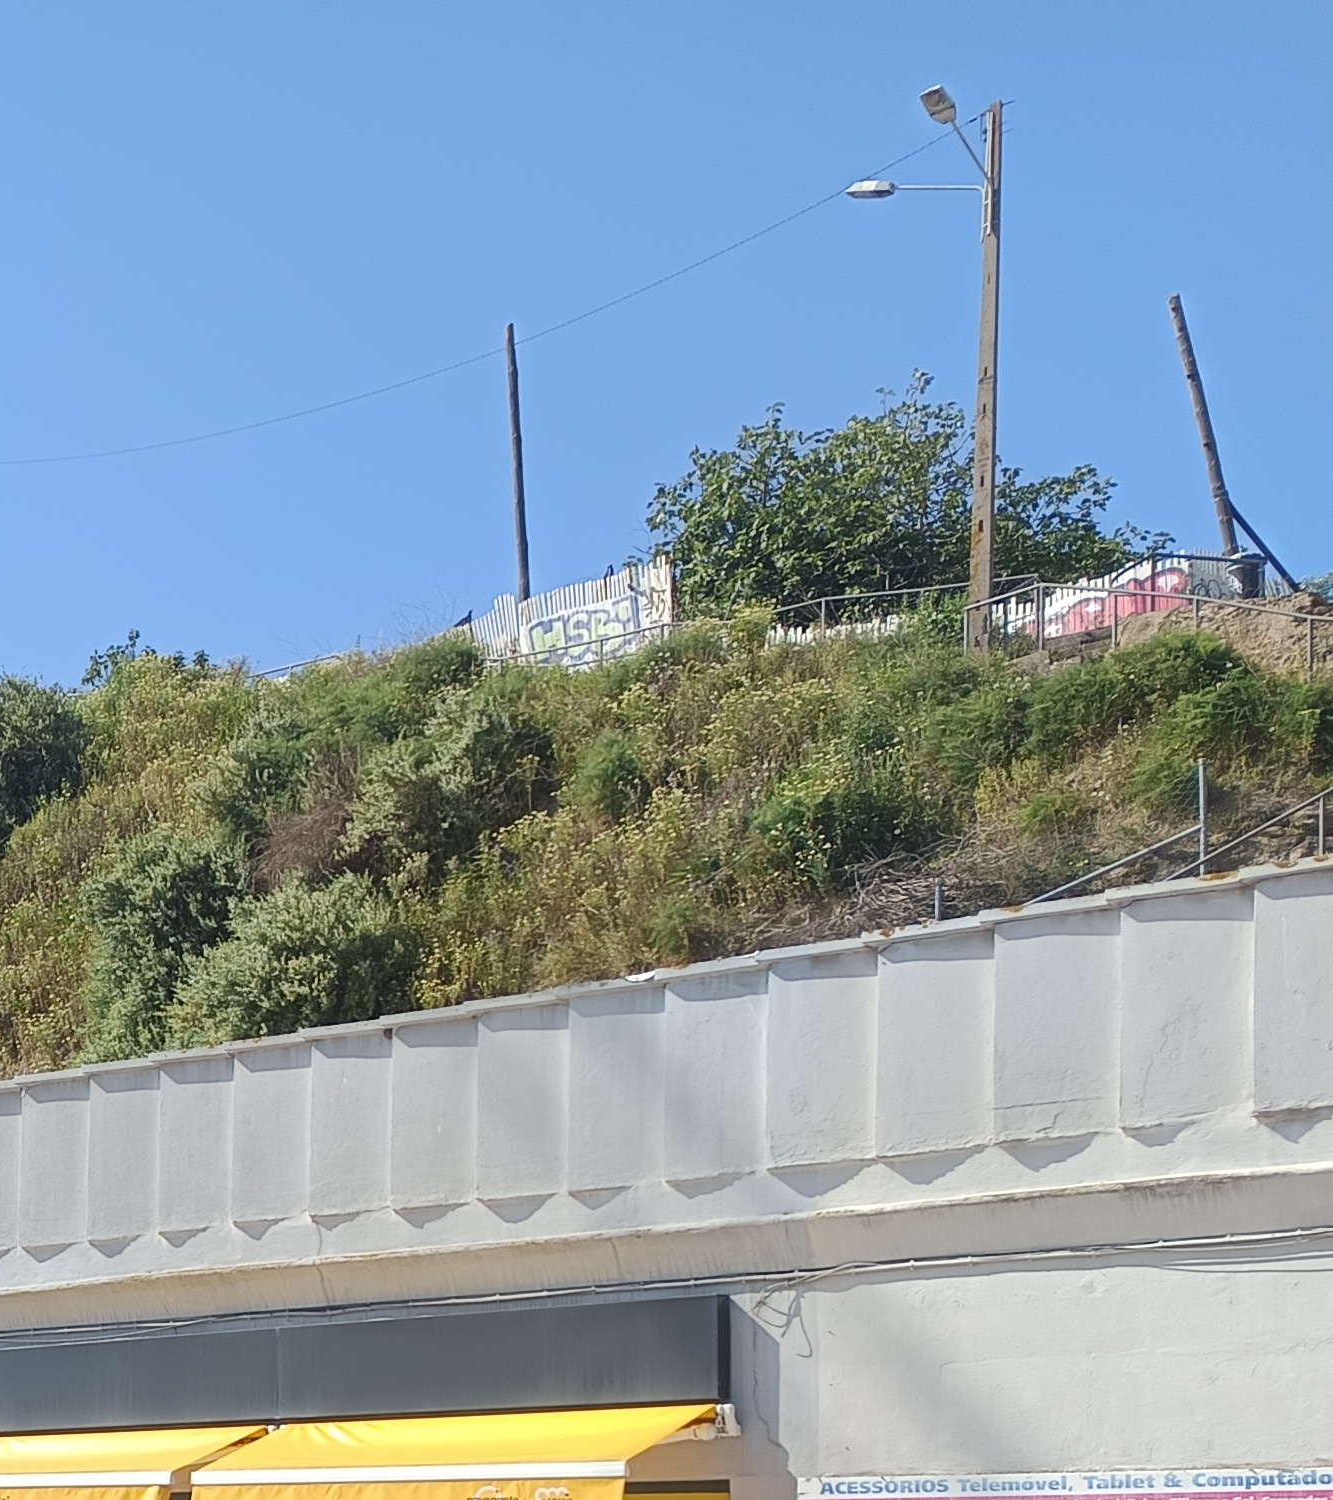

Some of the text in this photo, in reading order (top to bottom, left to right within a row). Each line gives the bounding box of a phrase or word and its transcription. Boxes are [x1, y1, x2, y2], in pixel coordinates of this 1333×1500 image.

[820, 1477, 949, 1495] ACESSÓRIOS
[957, 1475, 1073, 1493] Telemóvel,
[1083, 1474, 1156, 1490] Tablet
[1164, 1472, 1182, 1488] &
